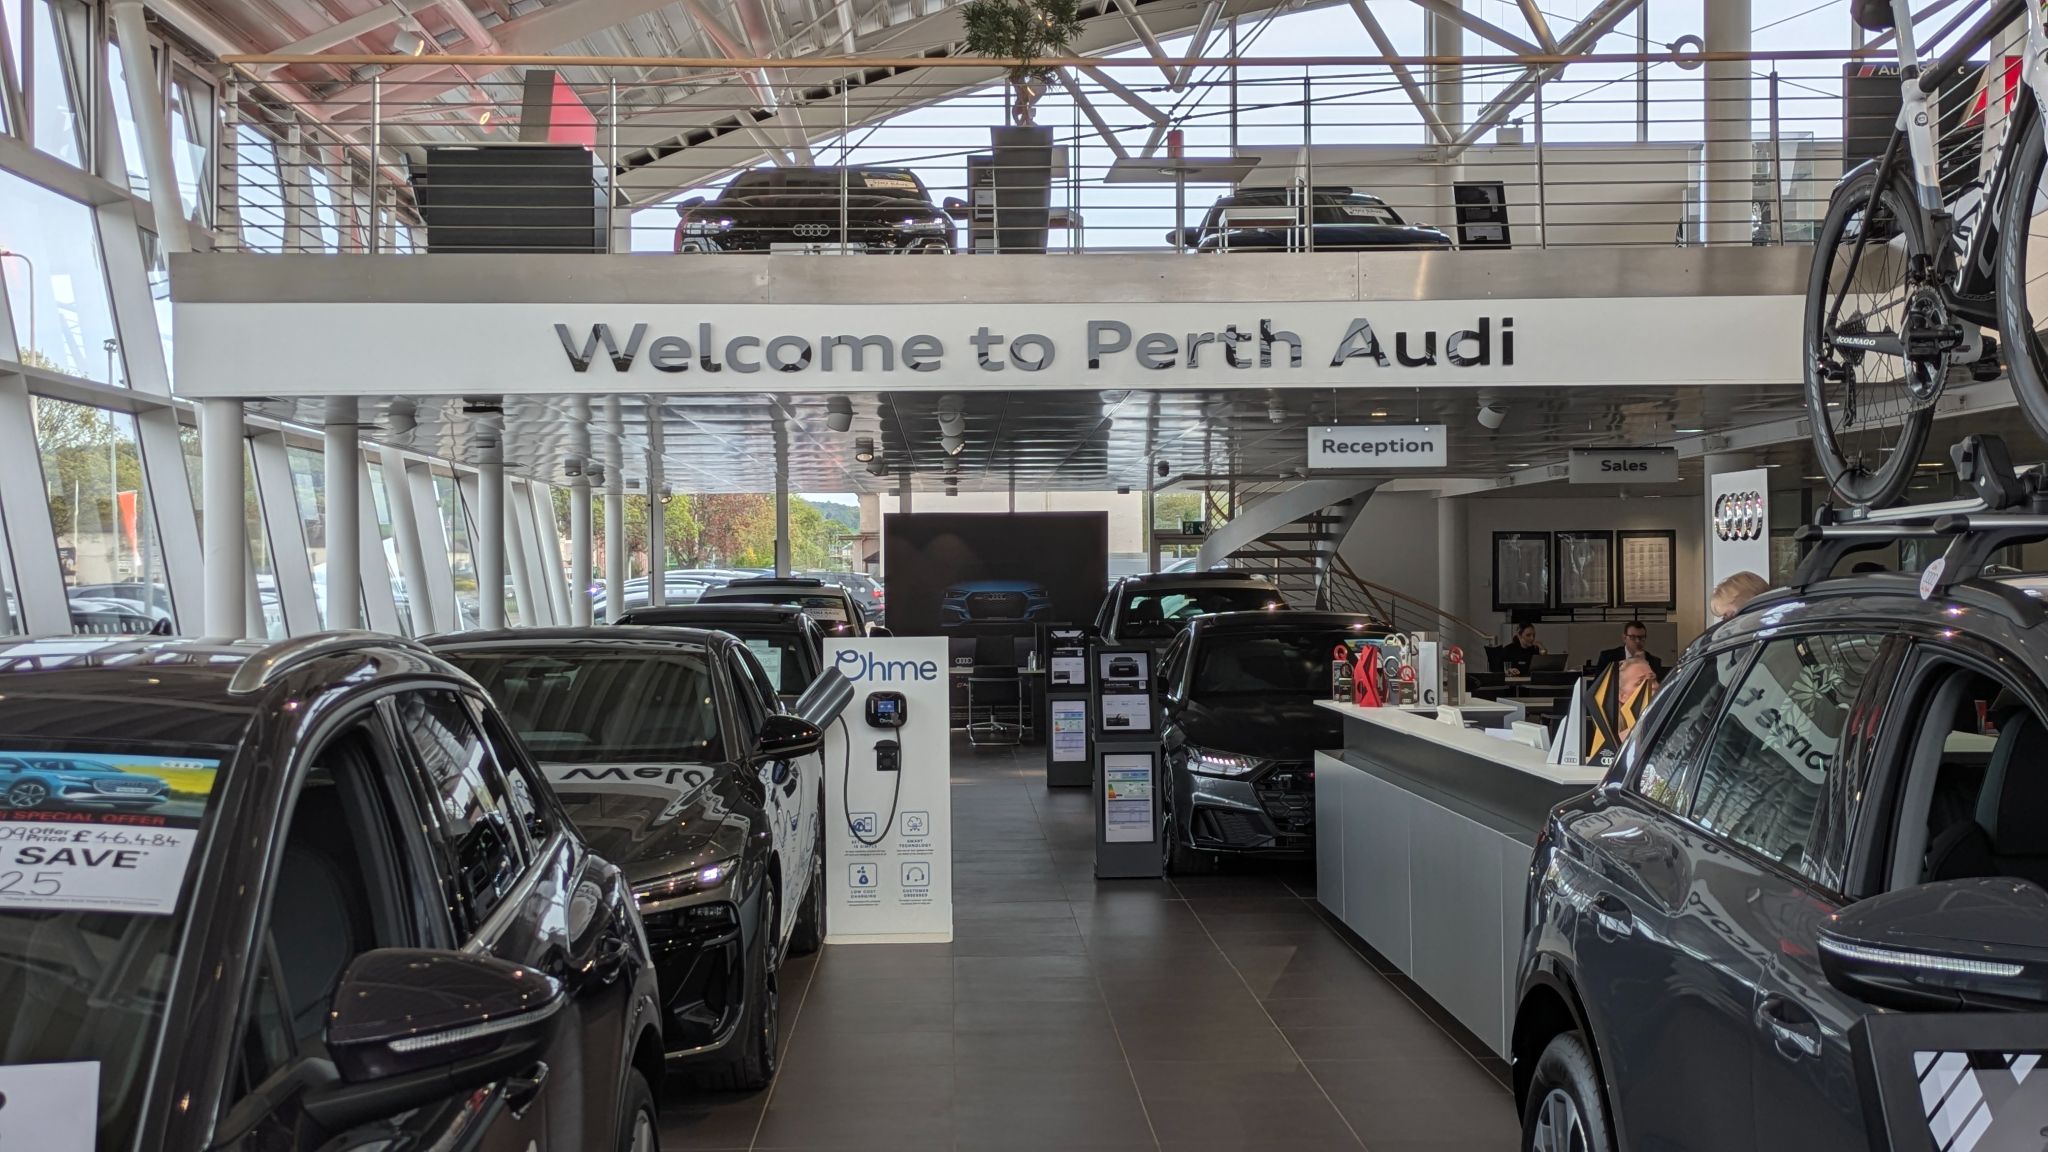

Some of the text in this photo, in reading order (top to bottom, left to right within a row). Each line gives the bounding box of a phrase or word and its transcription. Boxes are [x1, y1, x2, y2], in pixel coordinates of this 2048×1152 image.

[553, 316, 1514, 373] Welcome to Perth Audi
[1840, 337, 1876, 346] COLNAGO
[1321, 437, 1435, 455] Reception
[1600, 458, 1648, 472] Sales
[835, 649, 938, 682] Ohme
[14, 811, 95, 822] SPECIAL
[101, 813, 166, 825] OFFER
[26, 834, 67, 842] Price
[29, 827, 70, 835] Offer
[15, 846, 140, 869] SAVE
